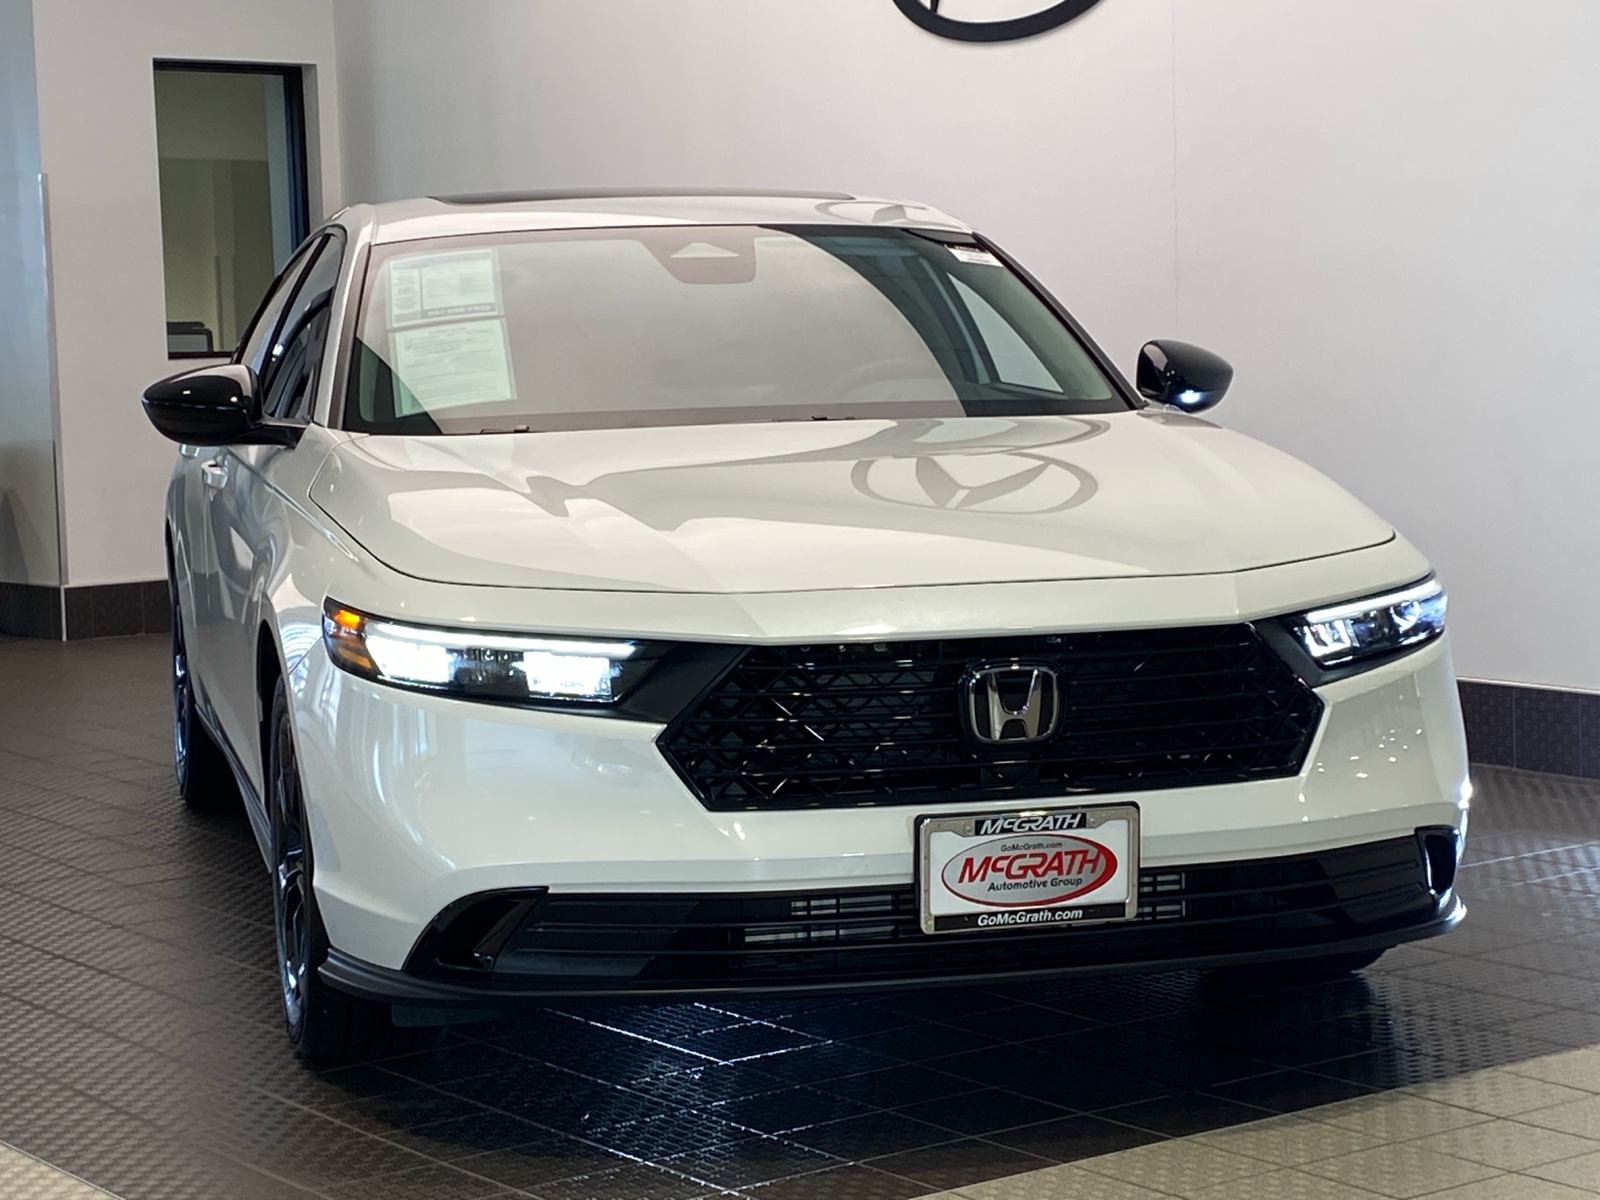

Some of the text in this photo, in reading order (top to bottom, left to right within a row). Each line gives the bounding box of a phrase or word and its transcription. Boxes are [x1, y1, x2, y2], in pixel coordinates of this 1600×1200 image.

[1001, 842, 1063, 852] GoMcGrath.com
[987, 877, 1083, 892] Automotive Group
[977, 909, 1083, 927] GoMcGrath.com
